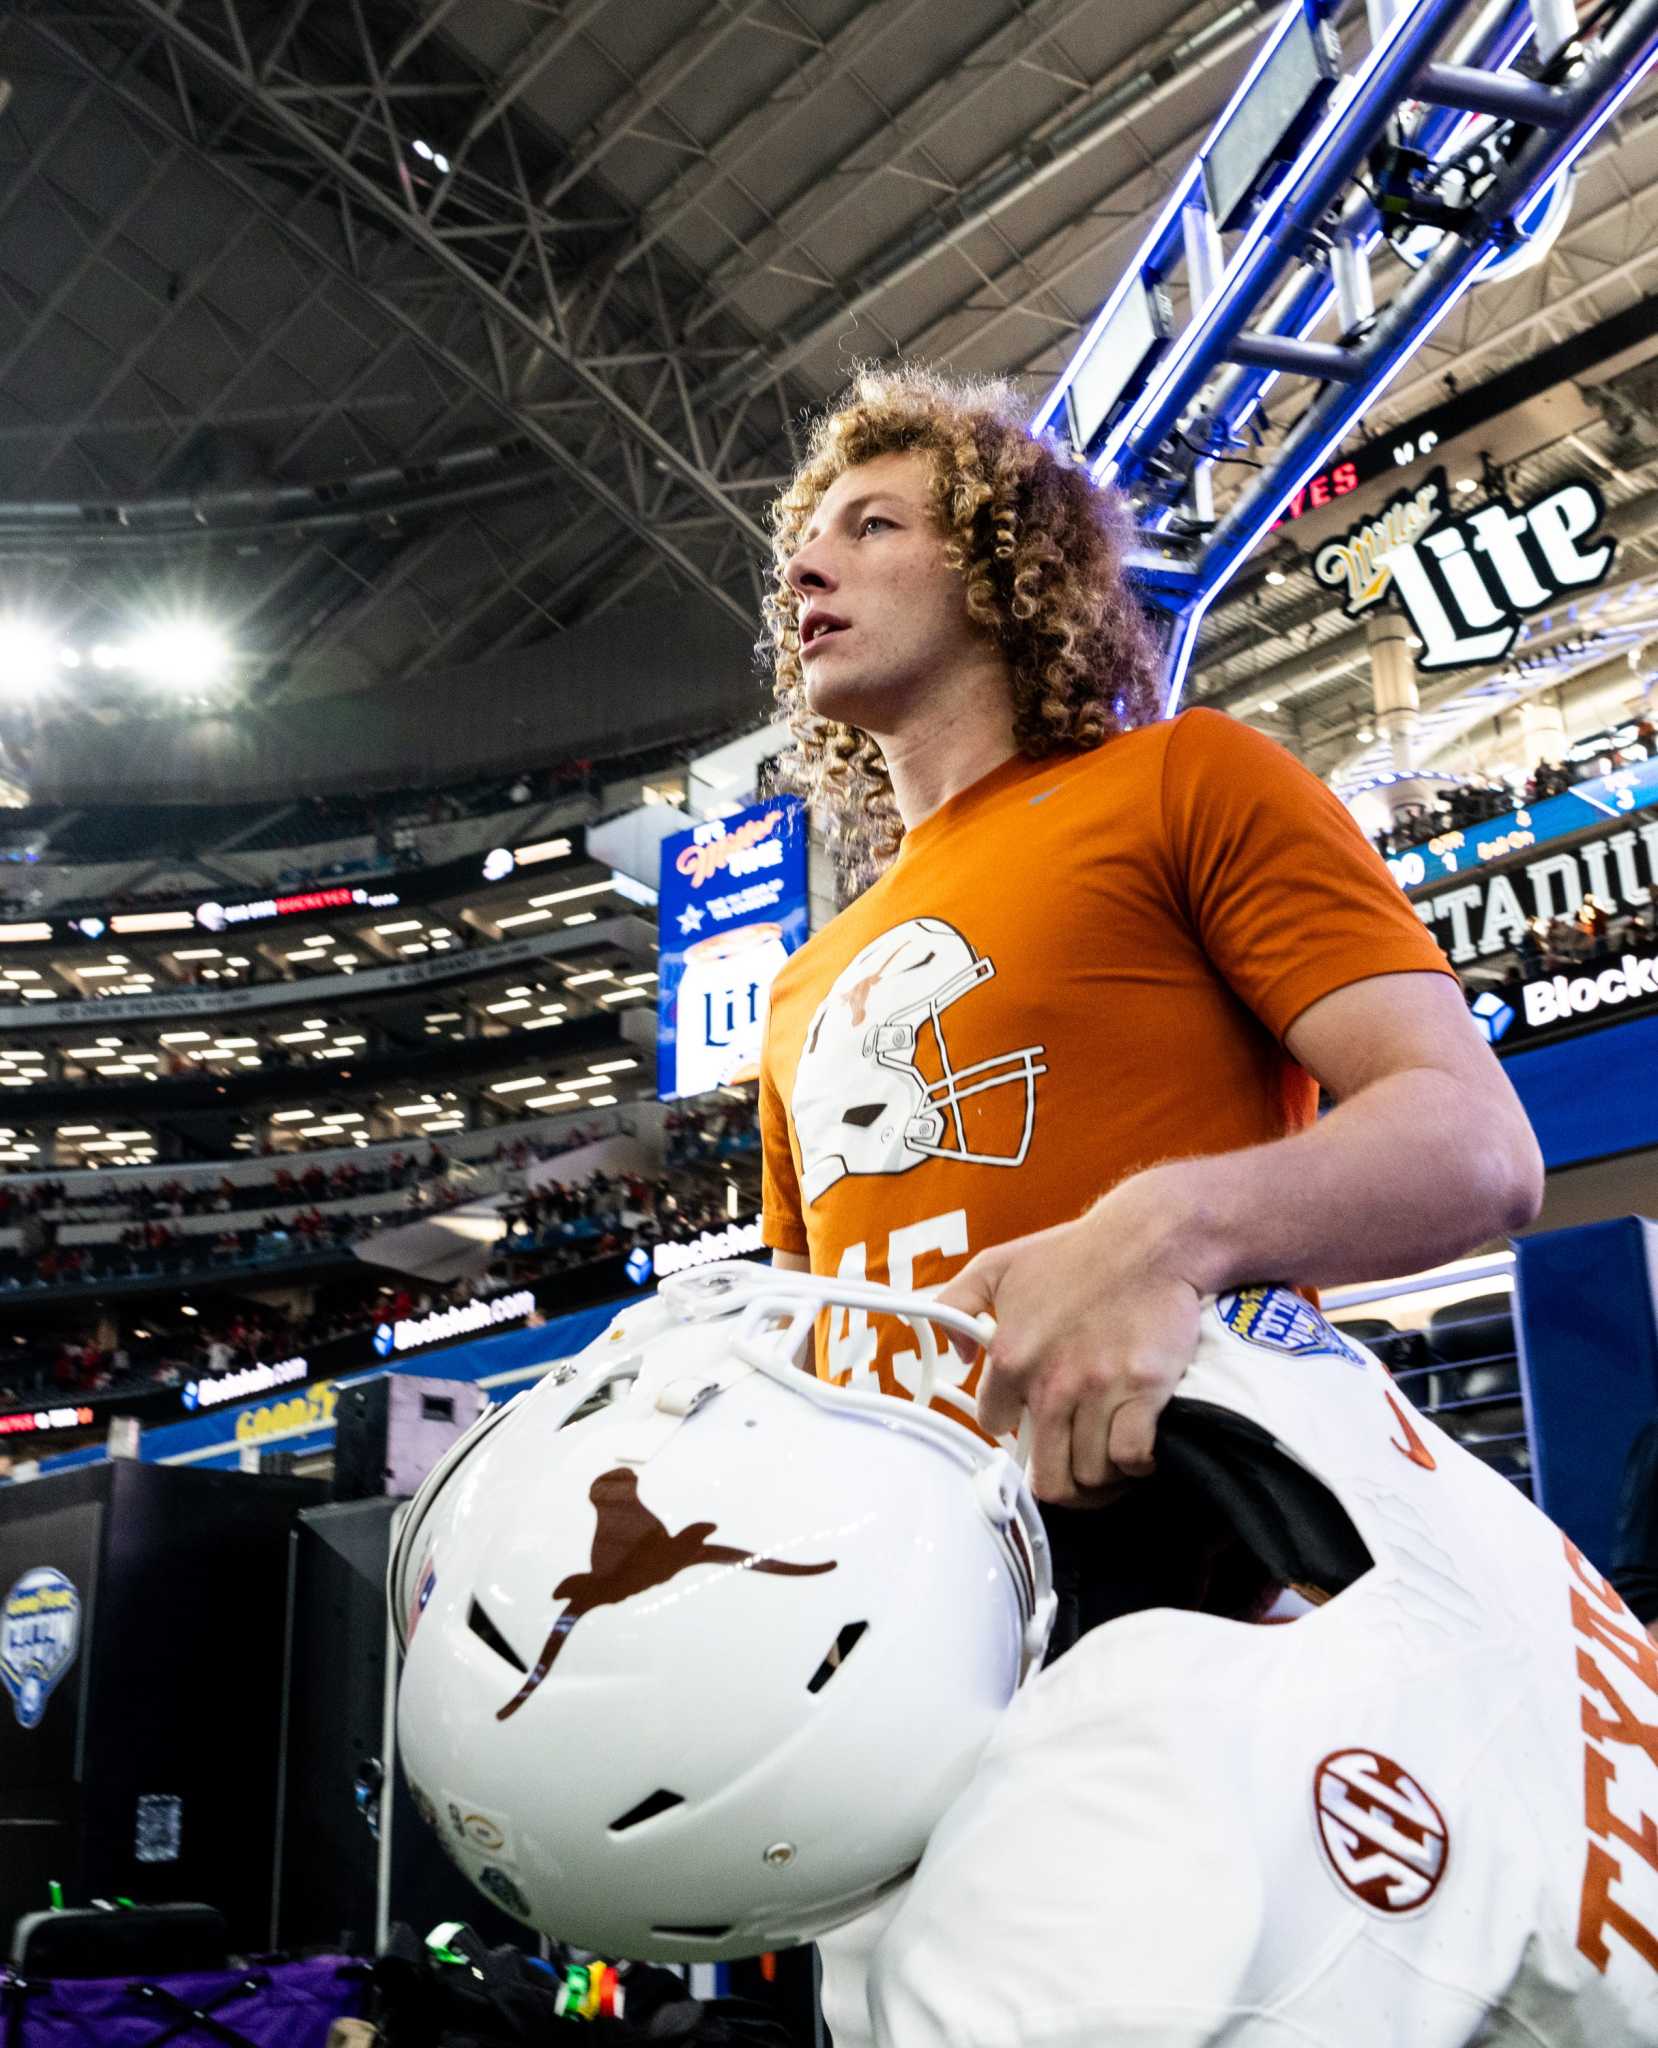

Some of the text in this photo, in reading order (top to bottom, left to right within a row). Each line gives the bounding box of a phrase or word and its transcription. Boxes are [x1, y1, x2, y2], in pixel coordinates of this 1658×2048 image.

[1315, 483, 1443, 615] Miller
[1374, 485, 1612, 667] Lite
[704, 981, 761, 1047] Lit
[654, 1213, 765, 1277] Blockchai
[829, 1208, 975, 1395] 45
[1316, 1750, 1448, 1912] SEC
